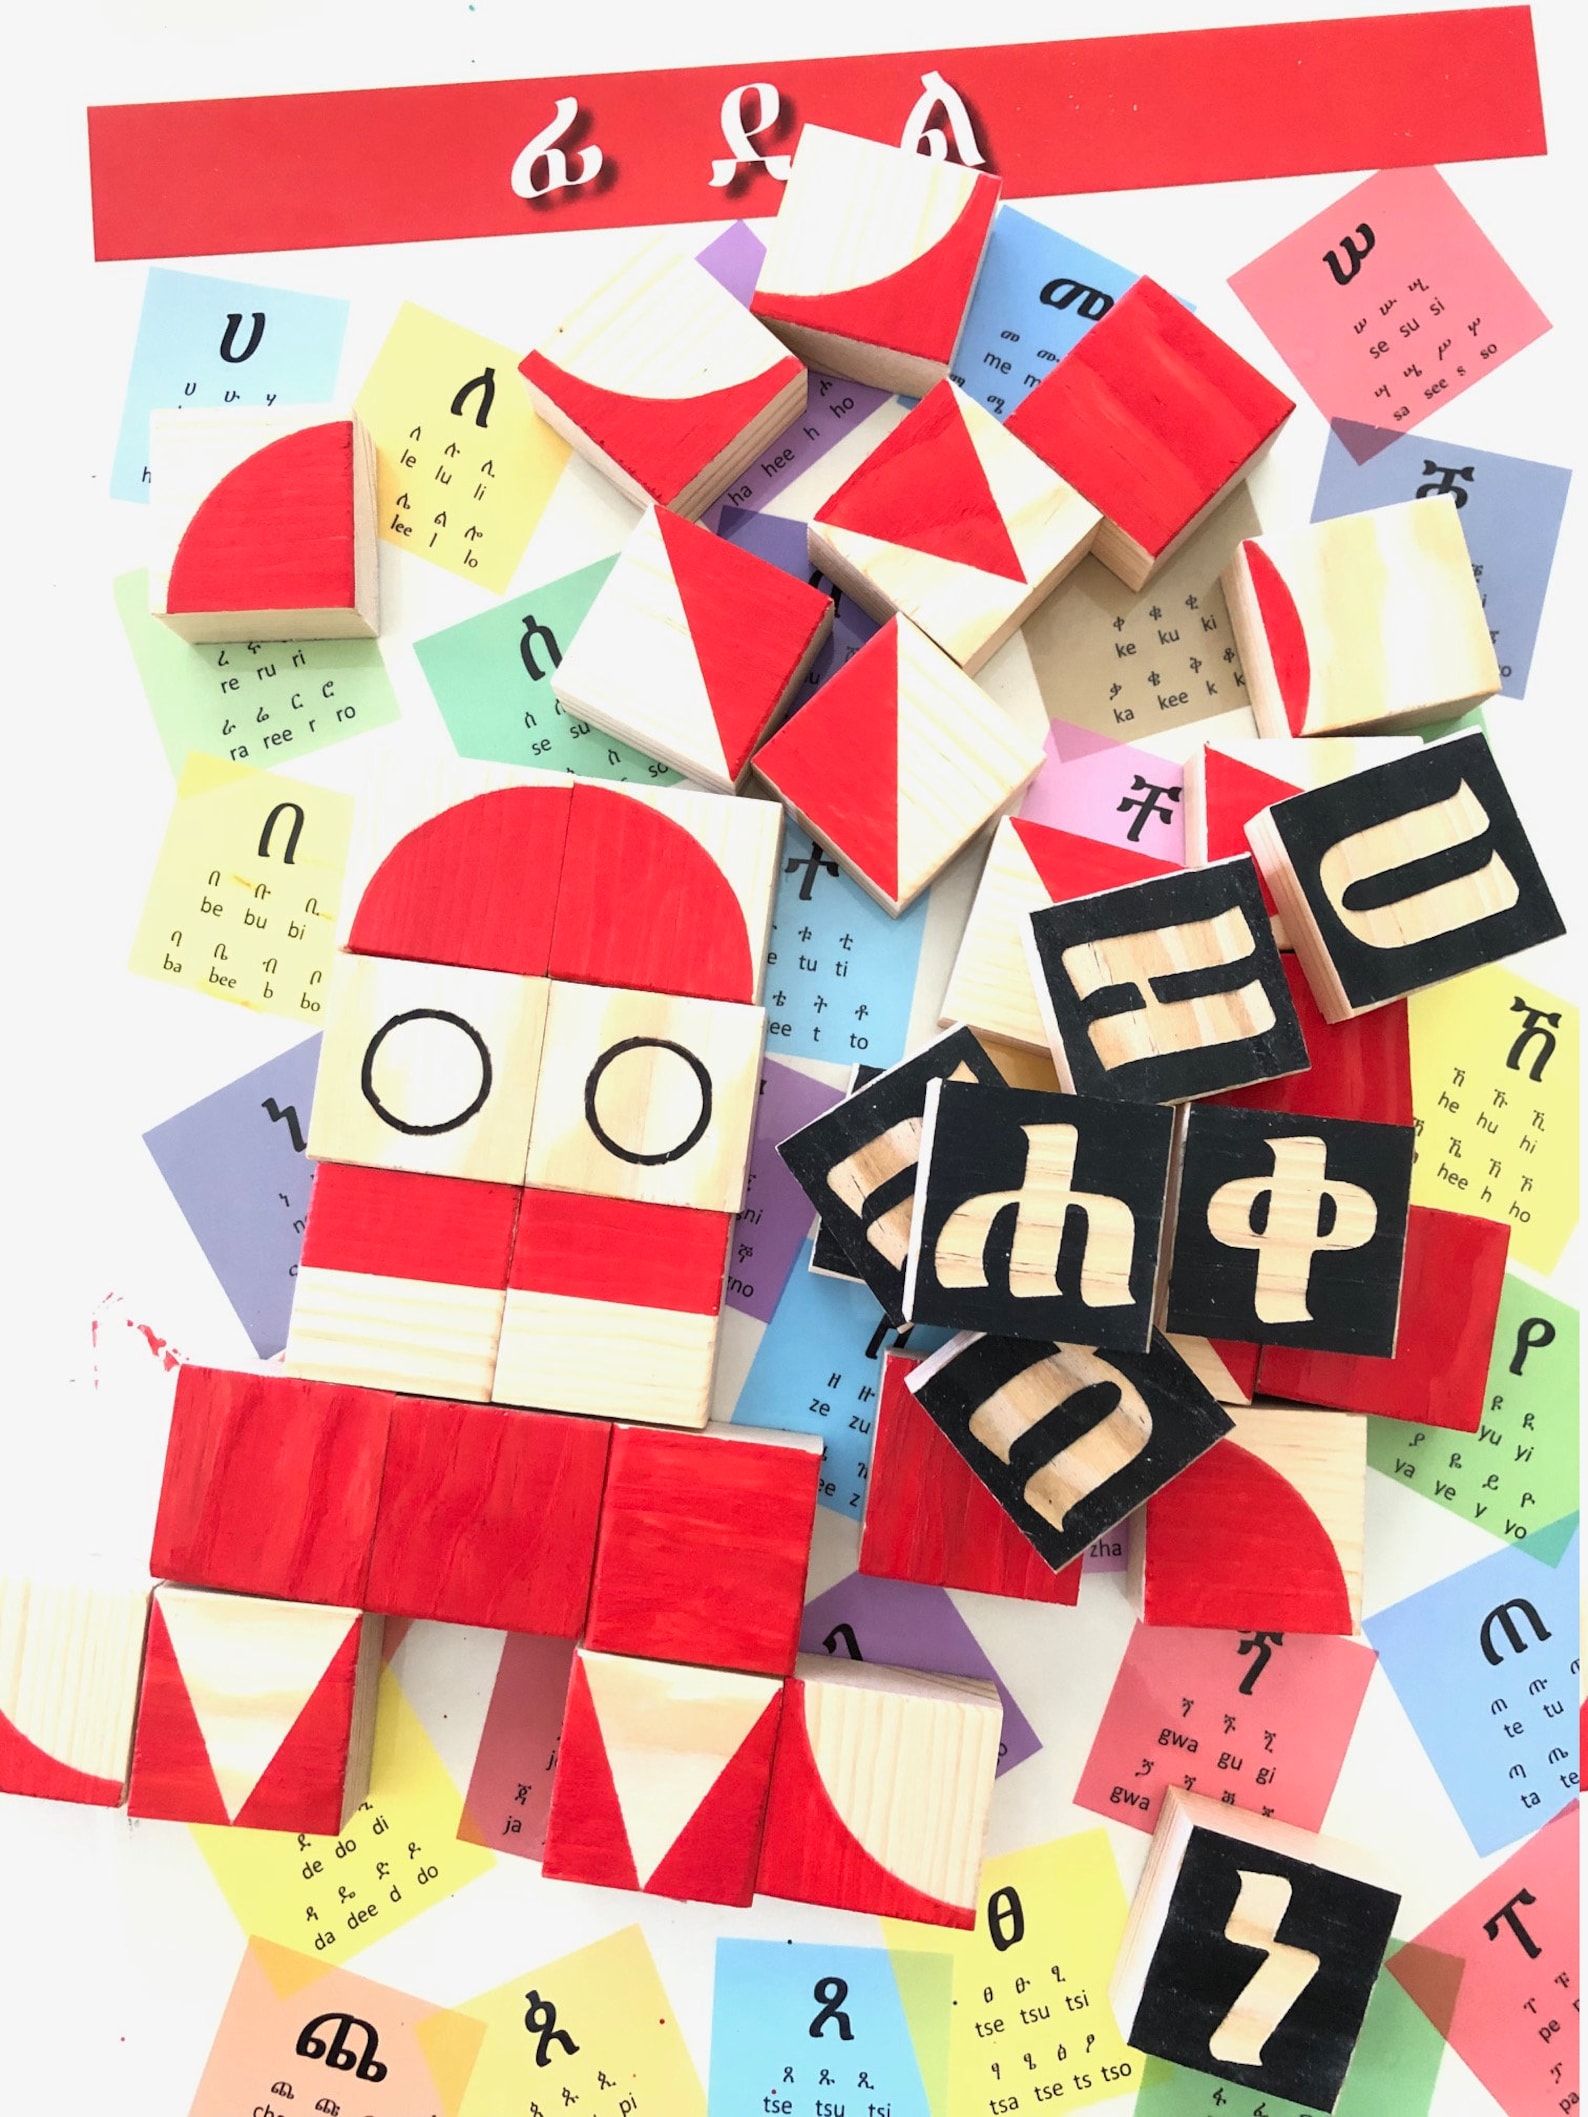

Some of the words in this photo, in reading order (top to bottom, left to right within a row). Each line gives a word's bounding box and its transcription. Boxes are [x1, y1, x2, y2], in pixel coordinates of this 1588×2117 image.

[1370, 341, 1389, 359] se
[1400, 319, 1419, 337] su
[1430, 297, 1444, 315] si
[1394, 407, 1410, 421] sa
[1424, 379, 1447, 399] see
[1457, 366, 1465, 376] s
[1481, 344, 1497, 359] so
[728, 485, 752, 506] ha
[761, 449, 795, 477] hee
[803, 427, 820, 440] h
[830, 398, 854, 418] ho
[401, 449, 416, 467] le
[435, 466, 452, 484] lu
[474, 484, 484, 500] li
[391, 514, 412, 536] lee
[464, 550, 478, 567] lo
[1115, 643, 1136, 658] ke
[1158, 630, 1180, 644] ku
[1201, 615, 1216, 631] ki
[221, 678, 239, 693] re
[257, 664, 276, 680] ru
[292, 650, 305, 667] ri
[1114, 709, 1134, 723] ka
[1158, 692, 1188, 710] kee
[1206, 681, 1217, 695] k
[230, 746, 248, 760] ra
[264, 730, 293, 749] ree
[309, 720, 315, 732] r
[336, 707, 355, 722] ro
[532, 739, 551, 755] se
[570, 722, 590, 738] su
[648, 762, 671, 777] so
[201, 896, 223, 916] be
[244, 909, 267, 929] bu
[288, 921, 304, 939] bi
[164, 953, 182, 972] ba
[209, 967, 236, 988] bee
[264, 982, 273, 998] b
[301, 992, 320, 1011] bo
[799, 955, 817, 971] tu
[836, 961, 848, 976] ti
[814, 1027, 820, 1041] t
[850, 1034, 868, 1049] to
[1438, 1092, 1459, 1113] he
[1477, 1112, 1498, 1134] hu
[1520, 1135, 1535, 1153] hi
[1437, 1163, 1468, 1190] hee
[1481, 1186, 1491, 1202] h
[1509, 1201, 1530, 1222] ho
[809, 1399, 830, 1416] ze
[849, 1416, 871, 1434] zu
[1478, 1425, 1502, 1446] yu
[1515, 1445, 1534, 1462] yi
[1395, 1458, 1415, 1478] ya
[1435, 1480, 1456, 1500] ye
[1475, 1503, 1487, 1518] y
[1505, 1520, 1526, 1539] yo
[1090, 1541, 1122, 1557] zha
[1504, 1722, 1523, 1737] te
[1544, 1701, 1564, 1717] tu
[1158, 1729, 1198, 1753] gwa
[1218, 1752, 1242, 1770] gu
[1256, 1768, 1276, 1784] gi
[1110, 1786, 1150, 1811] gwa
[1521, 1792, 1540, 1808] ta
[503, 1816, 521, 1834] ja
[303, 1861, 323, 1879] de
[336, 1840, 356, 1858] do
[373, 1815, 389, 1832] di
[315, 1932, 335, 1950] da
[348, 1905, 378, 1929] dee
[390, 1885, 401, 1902] d
[418, 1866, 438, 1884] do
[975, 2019, 1004, 2037] tse
[1020, 2006, 1050, 2024] tsu
[1066, 1990, 1088, 2011] tsi
[1539, 2020, 1560, 2043] pe
[619, 2093, 637, 2117] pi
[764, 2097, 792, 2114] tse
[816, 2100, 844, 2117] tsu
[869, 2104, 890, 2117] tsi
[990, 2097, 1018, 2115] tsa
[1035, 2083, 1063, 2101] tse
[1074, 2075, 1091, 2089] ts
[1102, 2063, 1131, 2081] tso
[1559, 2092, 1579, 2114] pa
